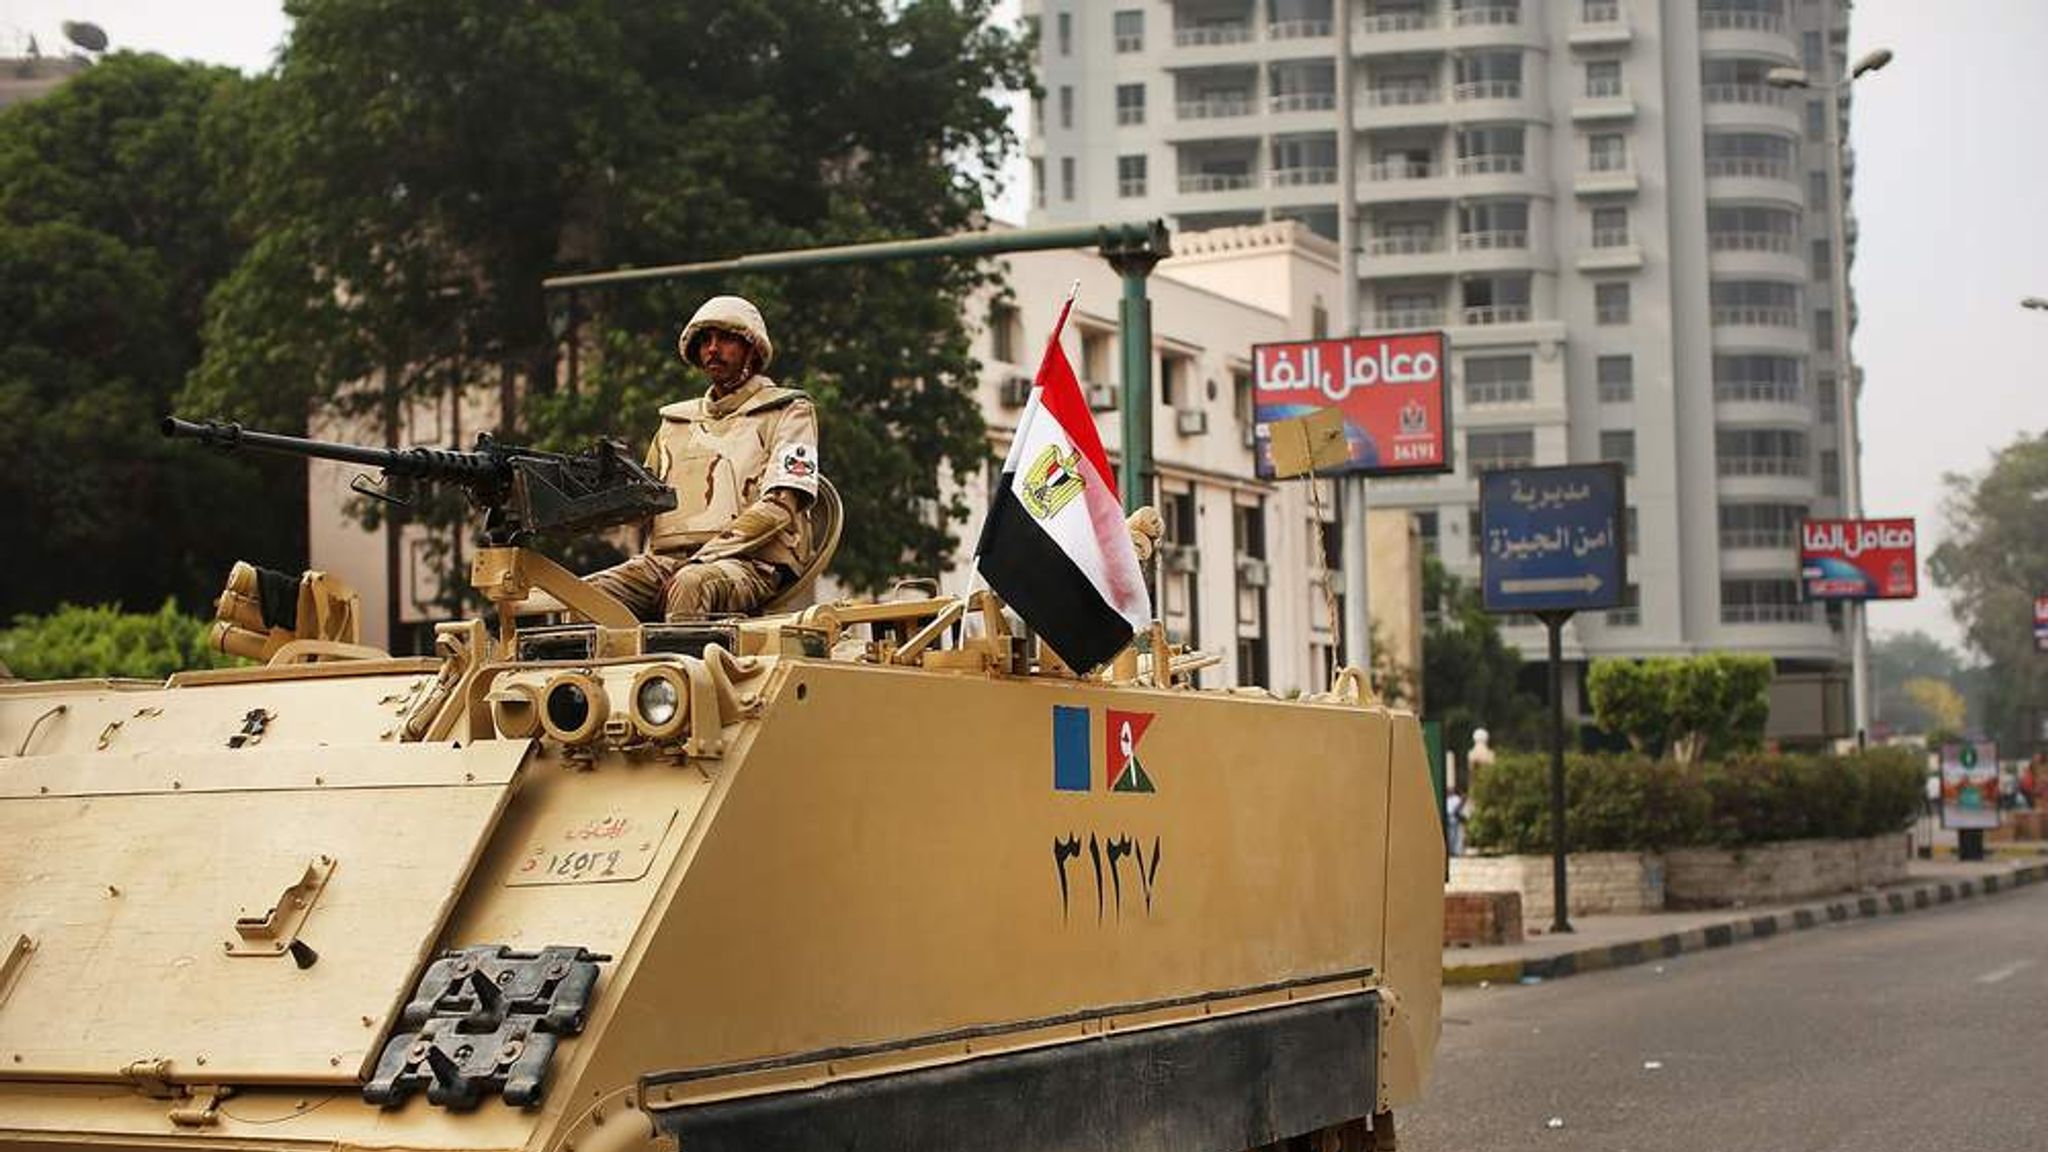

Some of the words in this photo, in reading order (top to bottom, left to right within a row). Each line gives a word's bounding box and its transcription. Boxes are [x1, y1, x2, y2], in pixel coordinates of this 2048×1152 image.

[1255, 348, 1320, 391] الفا
[1322, 344, 1437, 400] معامل
[1510, 479, 1591, 510] مديرية
[1489, 525, 1570, 559] الجيزة
[1572, 516, 1614, 558] أمن
[1803, 523, 1844, 552] الفا
[1845, 523, 1914, 558] معامل
[1053, 831, 1161, 927] ٣١٣٧
